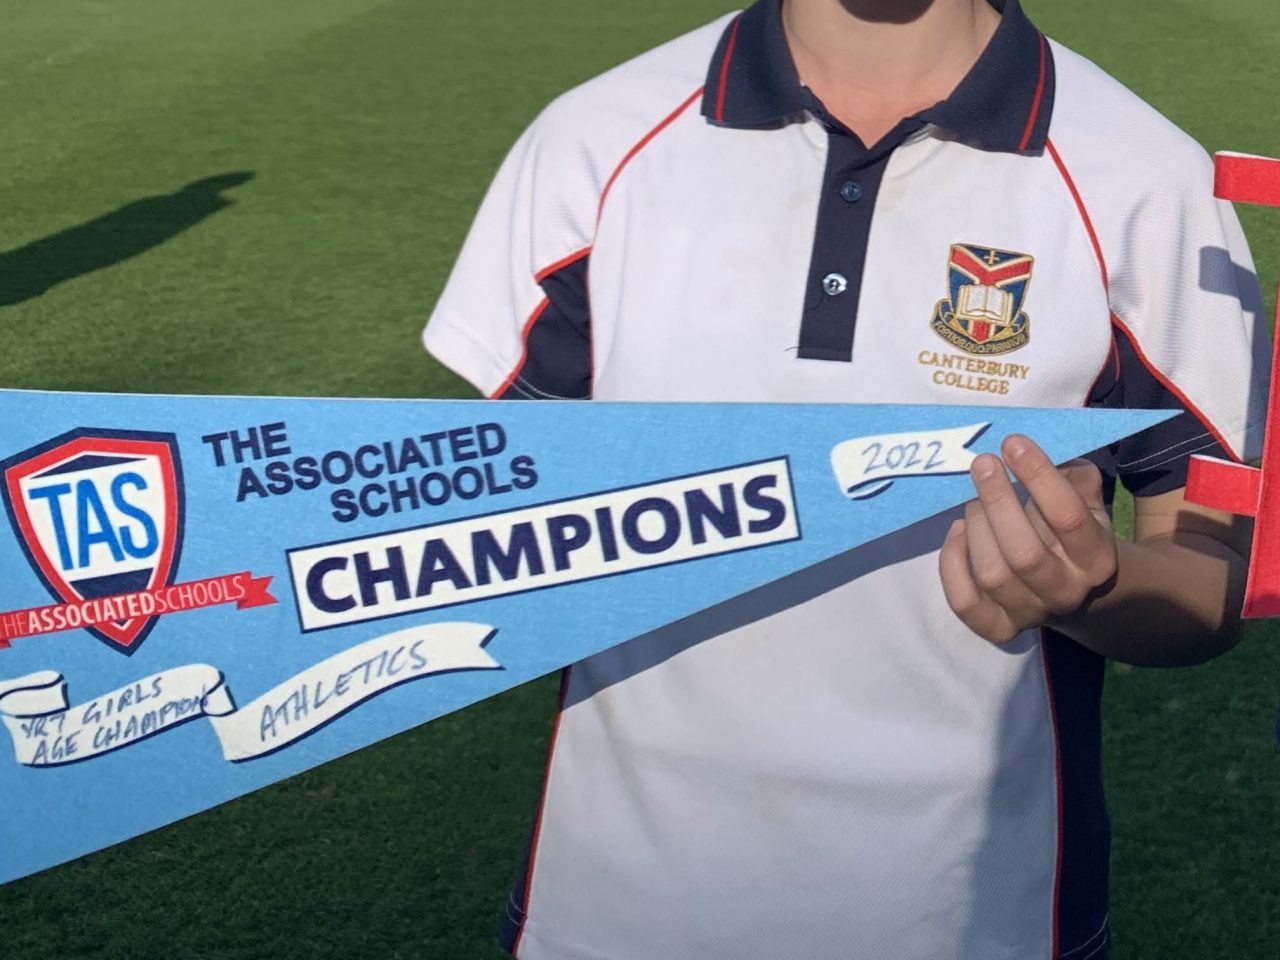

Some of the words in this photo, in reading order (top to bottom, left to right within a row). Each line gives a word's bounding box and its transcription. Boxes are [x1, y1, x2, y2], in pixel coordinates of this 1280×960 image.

[918, 350, 1031, 379] CANTERBURY
[932, 370, 1010, 395] COLLEGE
[202, 422, 291, 466] THE
[236, 422, 507, 502] ASSOCIATED
[862, 441, 946, 475] 2022
[28, 472, 159, 571] TAS
[331, 456, 539, 523] SCHOOLS
[306, 474, 786, 614] CHAMPIONS
[0, 576, 246, 638] HEASSOCIATEDSCHOOLS
[82, 677, 163, 724] GIRLS
[261, 640, 427, 741] ATHLETICS
[32, 730, 82, 763] AGE
[93, 685, 209, 749] CHAMPION
